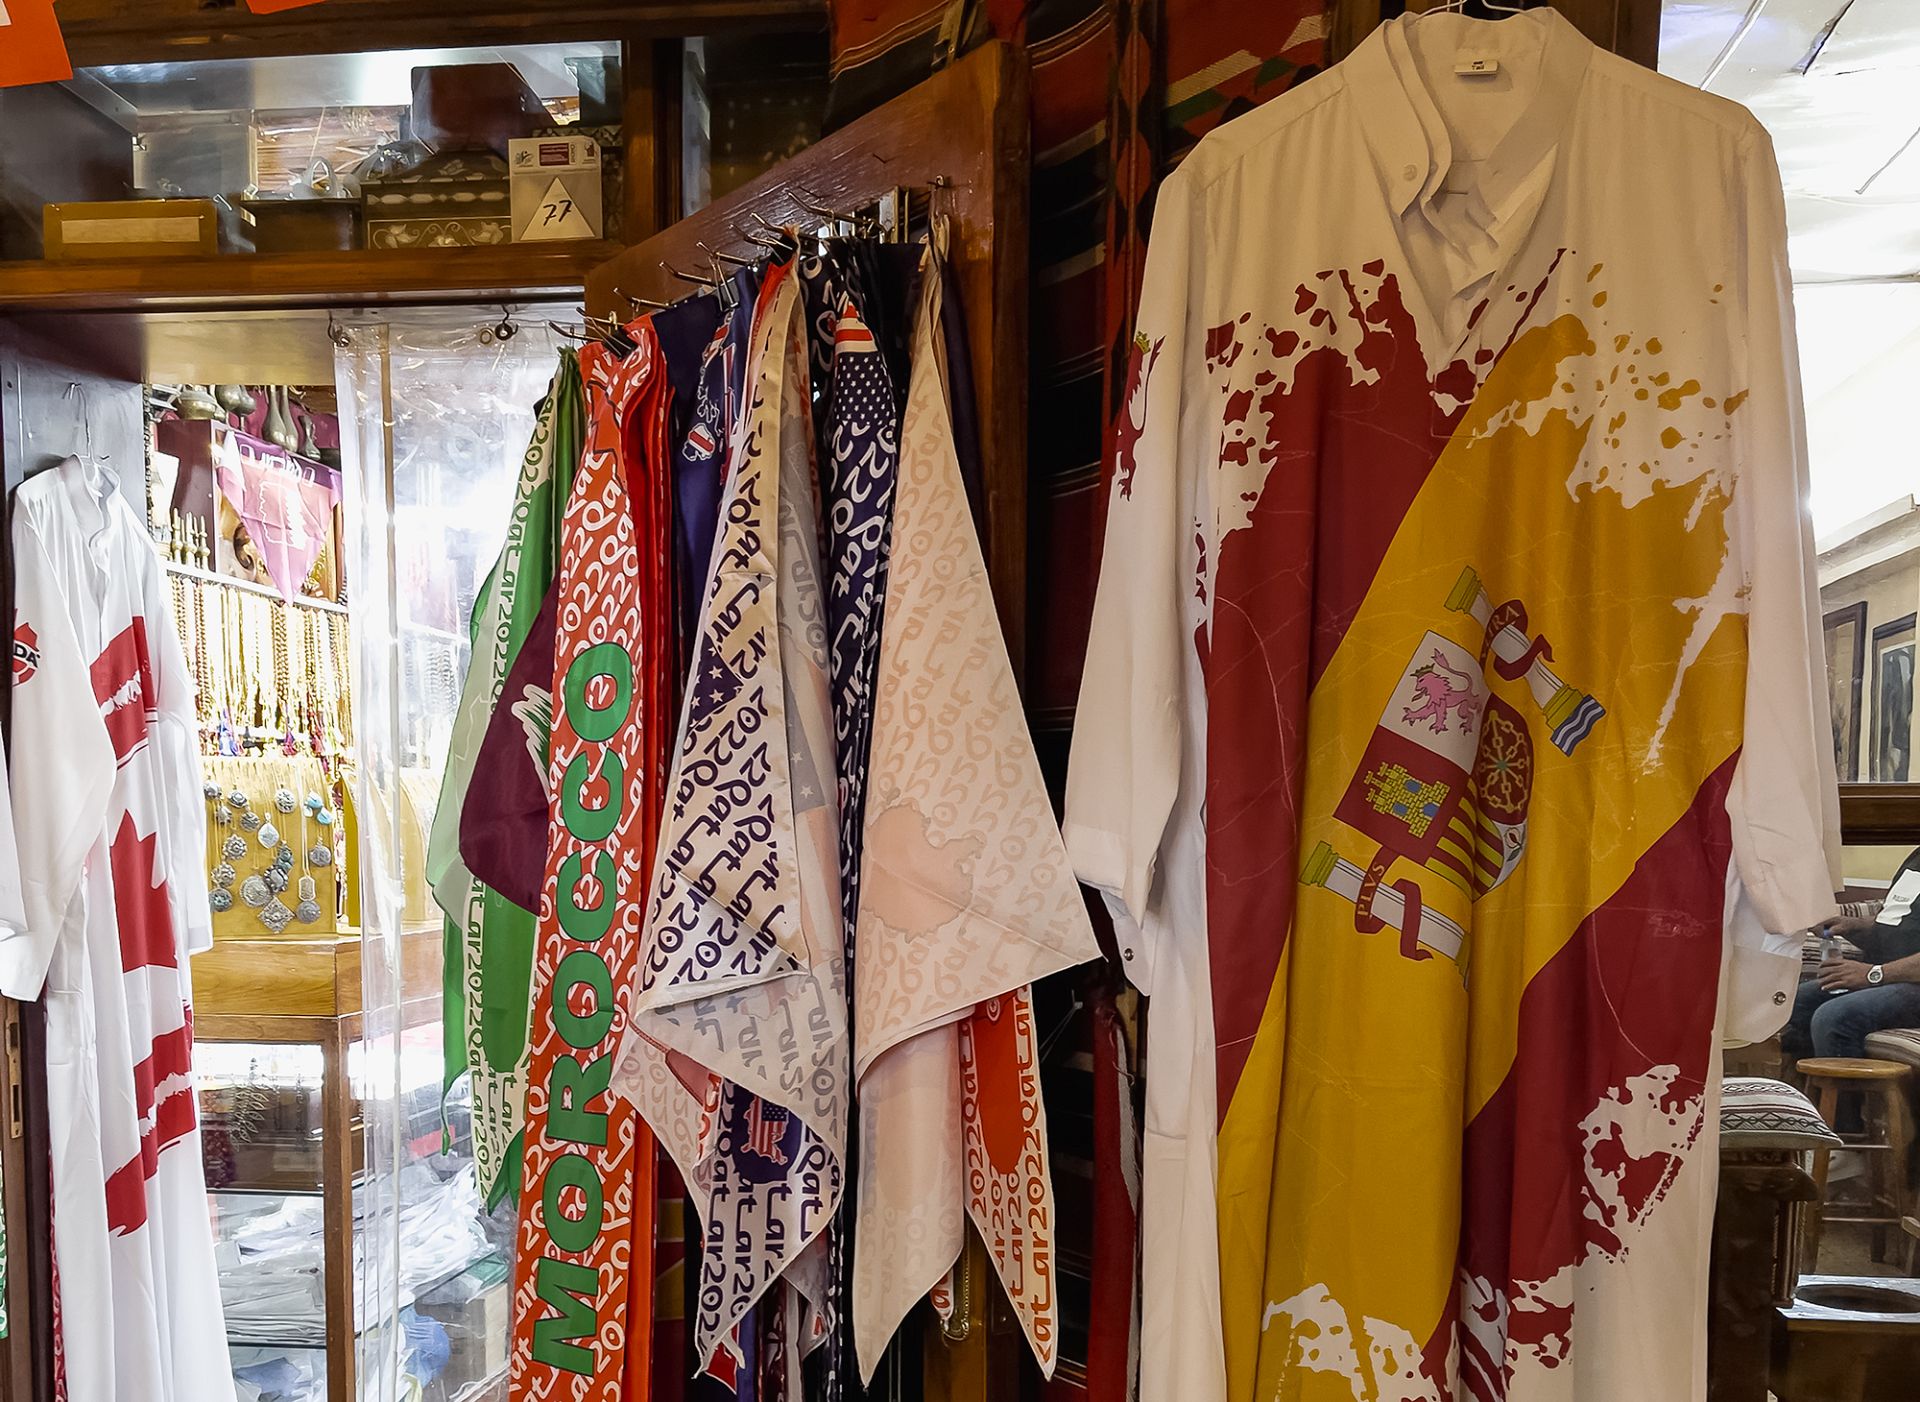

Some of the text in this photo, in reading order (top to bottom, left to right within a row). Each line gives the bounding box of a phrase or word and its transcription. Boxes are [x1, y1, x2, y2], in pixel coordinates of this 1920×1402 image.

[543, 199, 572, 226] 77
[1357, 863, 1385, 916] PLVS
[532, 642, 633, 1377] MOROCCO
